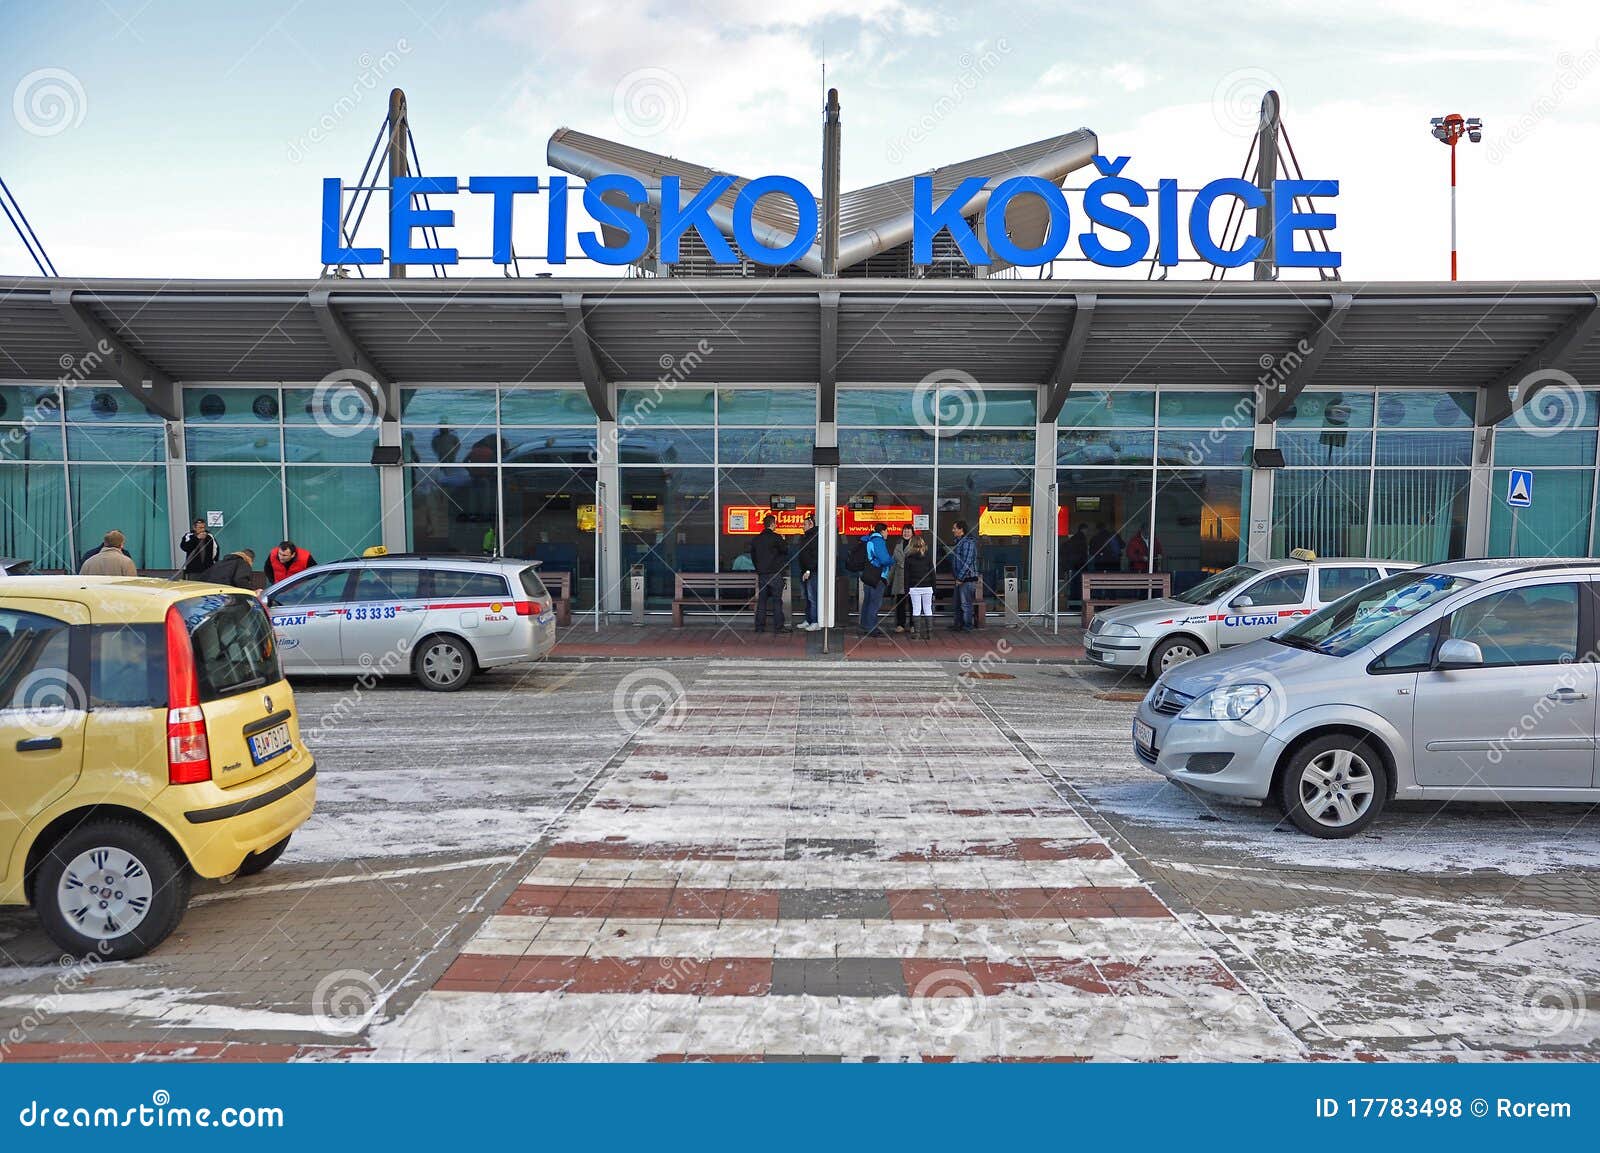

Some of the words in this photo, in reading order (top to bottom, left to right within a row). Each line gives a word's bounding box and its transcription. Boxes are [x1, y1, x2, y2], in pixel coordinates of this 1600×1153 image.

[321, 175, 819, 265] LETISKO
[913, 155, 1342, 268] KOŠICE
[988, 515, 1028, 525] Austrian
[346, 609, 352, 620] 6
[355, 608, 367, 620] 33
[369, 608, 381, 620] 33
[384, 607, 396, 618] 33
